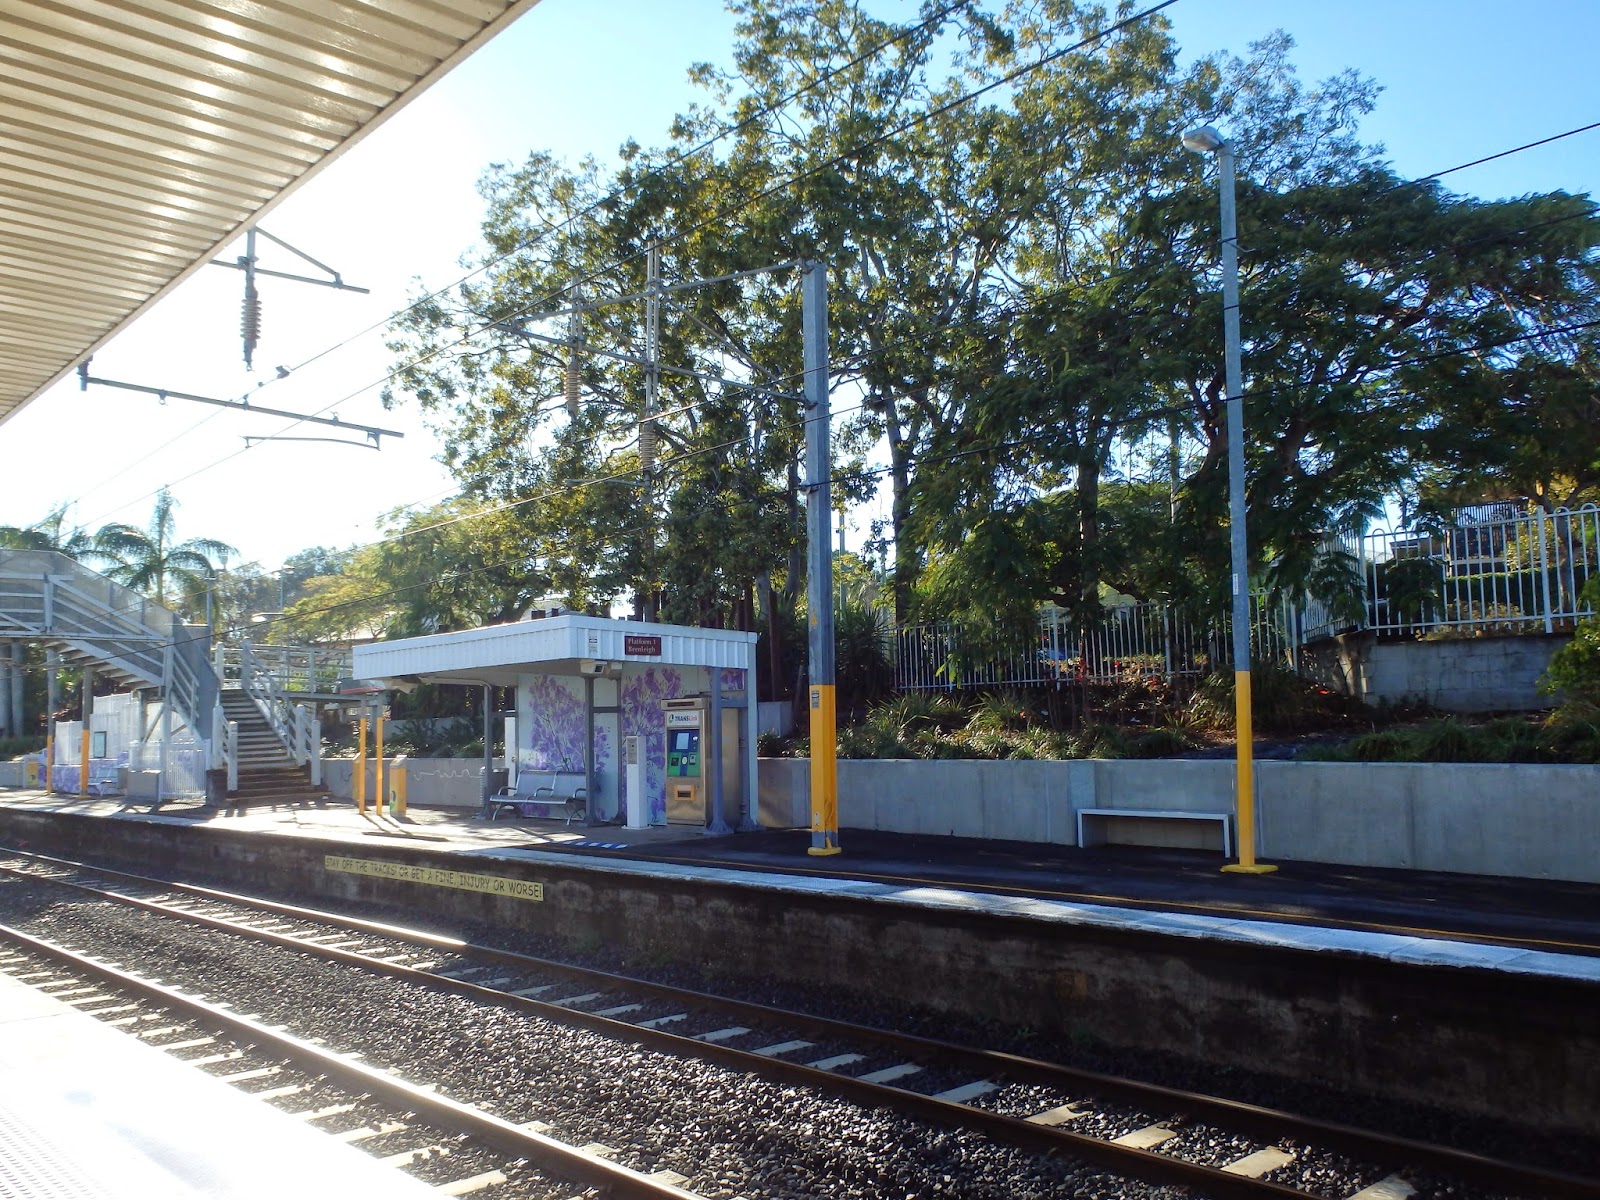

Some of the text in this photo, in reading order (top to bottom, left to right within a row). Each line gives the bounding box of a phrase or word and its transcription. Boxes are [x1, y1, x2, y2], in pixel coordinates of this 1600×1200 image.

[326, 857, 339, 868] STAY
[342, 859, 353, 869] OFF
[356, 861, 368, 872] THE
[399, 866, 409, 877] OR
[411, 868, 425, 880] GET
[427, 871, 432, 880] A
[435, 870, 456, 885] FINE,
[460, 874, 490, 889] INJURY
[493, 879, 505, 891] OR
[508, 881, 542, 898] WORSE!
